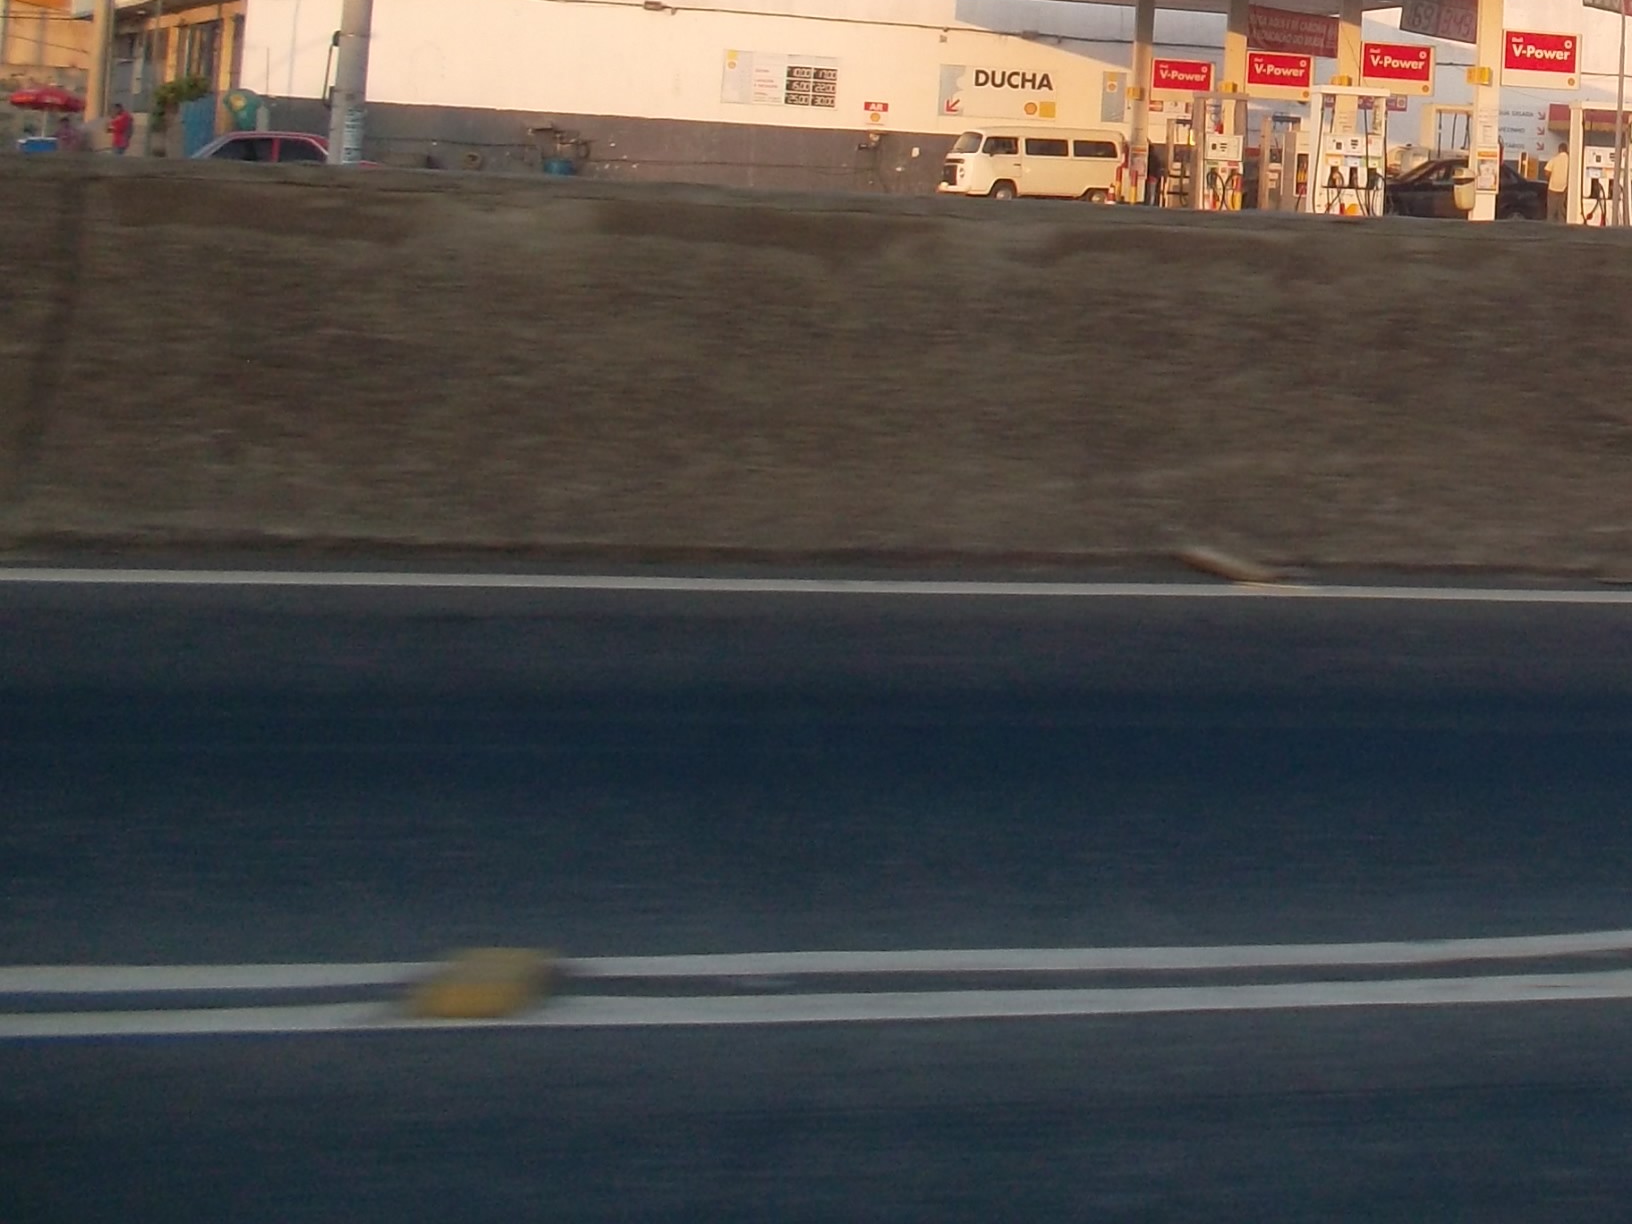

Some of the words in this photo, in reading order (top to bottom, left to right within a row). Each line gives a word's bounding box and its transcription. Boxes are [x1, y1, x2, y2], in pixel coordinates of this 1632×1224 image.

[1512, 43, 1570, 61] V-Power
[1370, 54, 1425, 70] V-Power
[1160, 69, 1206, 82] V-Power
[1254, 63, 1305, 77] V-Power
[974, 69, 1054, 91] DUCHA
[869, 102, 884, 112] AR
